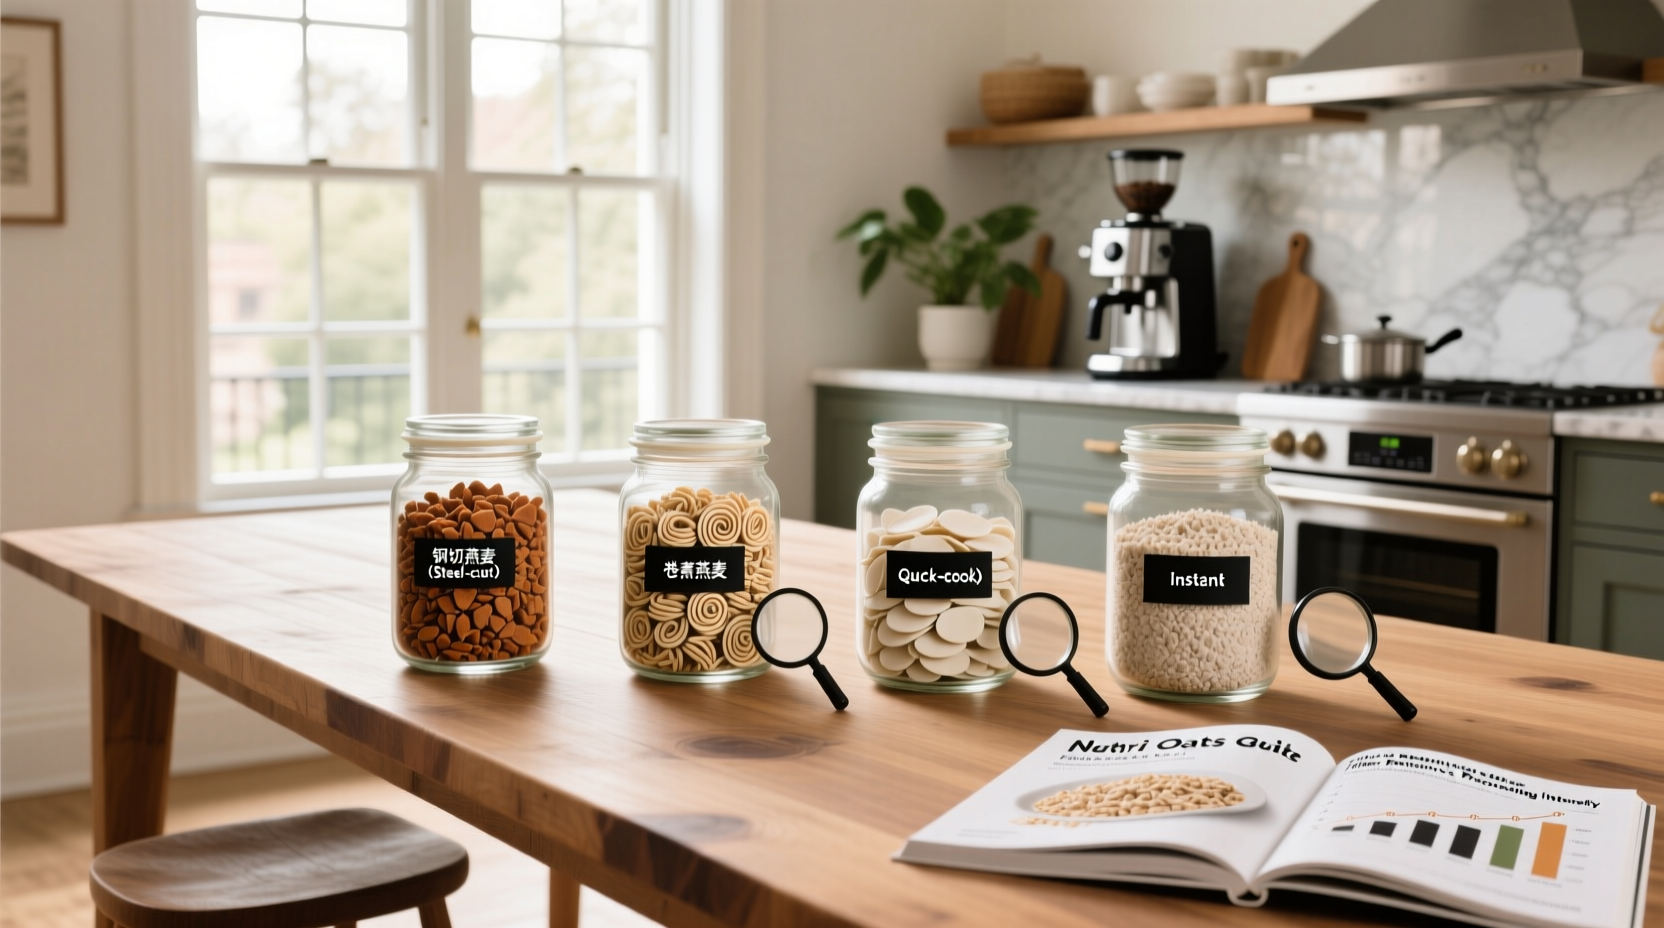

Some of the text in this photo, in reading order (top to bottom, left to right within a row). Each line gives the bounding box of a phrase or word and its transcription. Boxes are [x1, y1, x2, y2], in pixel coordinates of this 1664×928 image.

[898, 567, 983, 586] Quck-cook)
[1170, 571, 1225, 587] Instant
[1156, 736, 1226, 749] Oats
